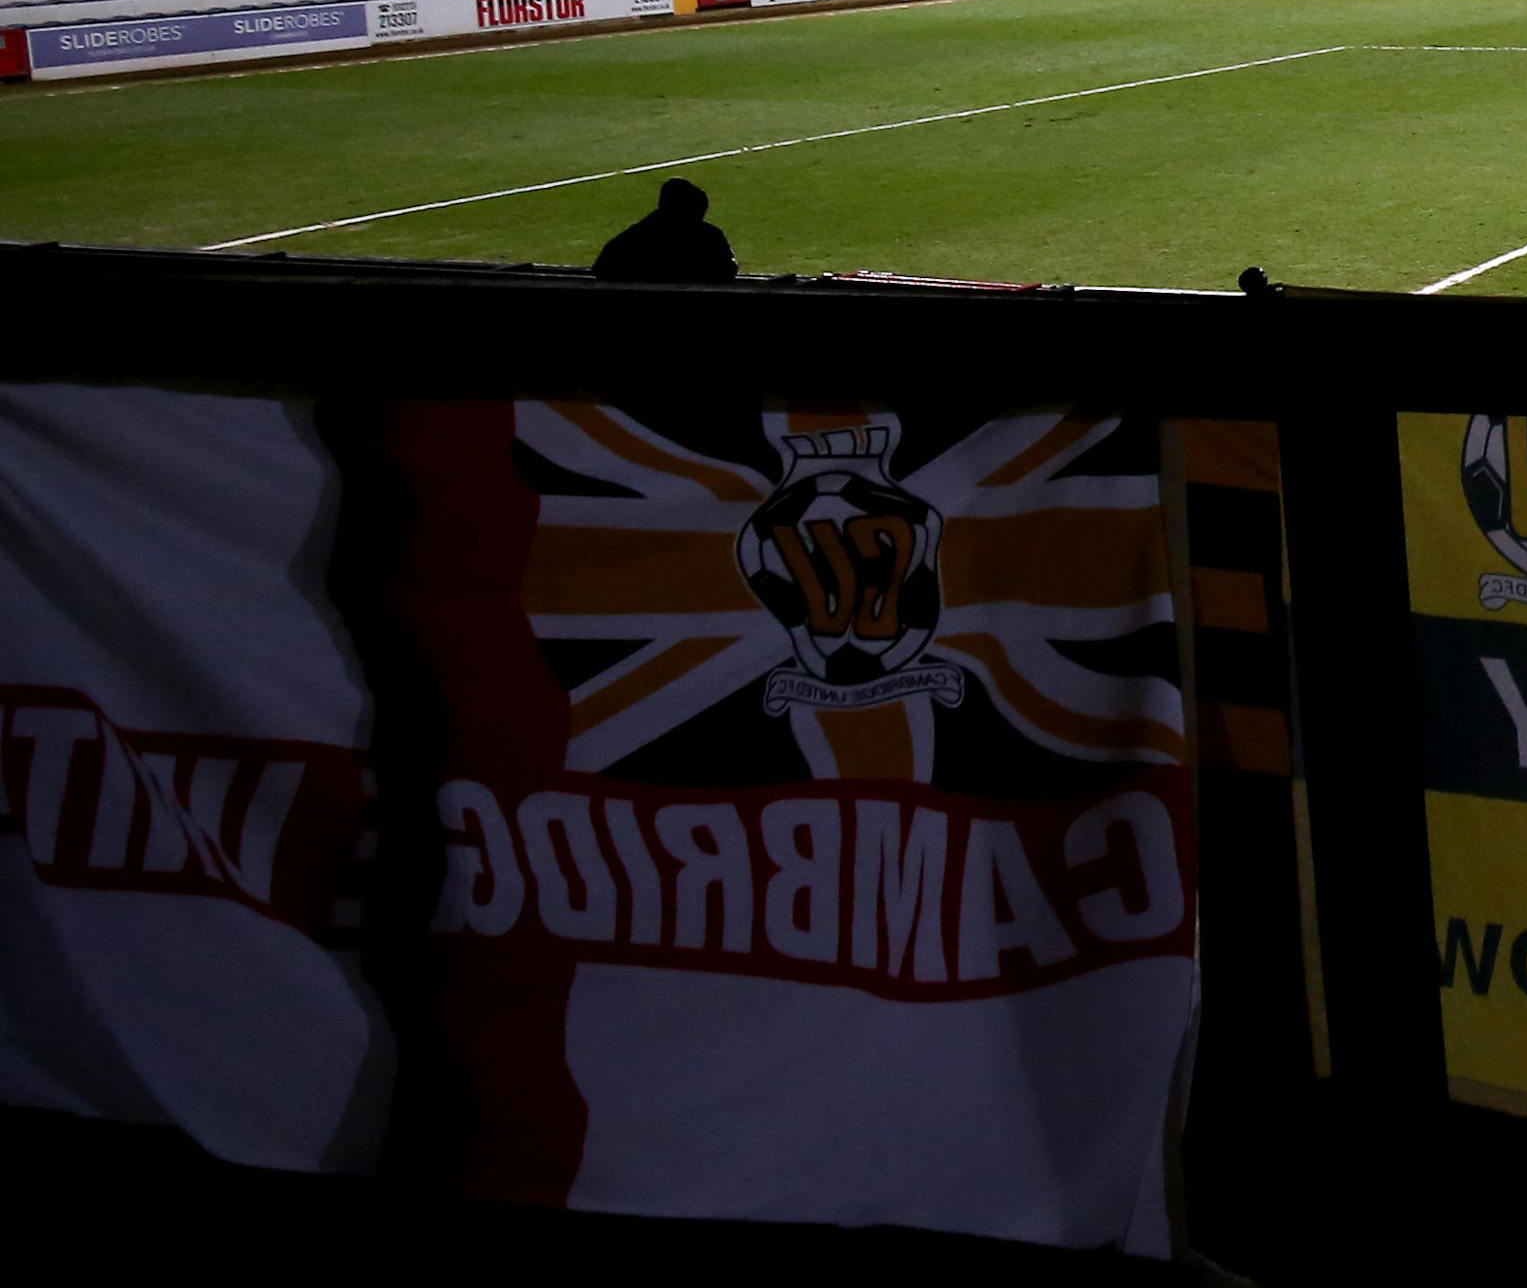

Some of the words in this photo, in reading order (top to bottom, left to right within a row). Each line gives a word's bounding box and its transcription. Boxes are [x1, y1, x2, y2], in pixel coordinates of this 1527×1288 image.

[233, 11, 342, 35] SLIDEROBES
[378, 9, 419, 29] 213307
[60, 27, 182, 51] SLIDEROBES
